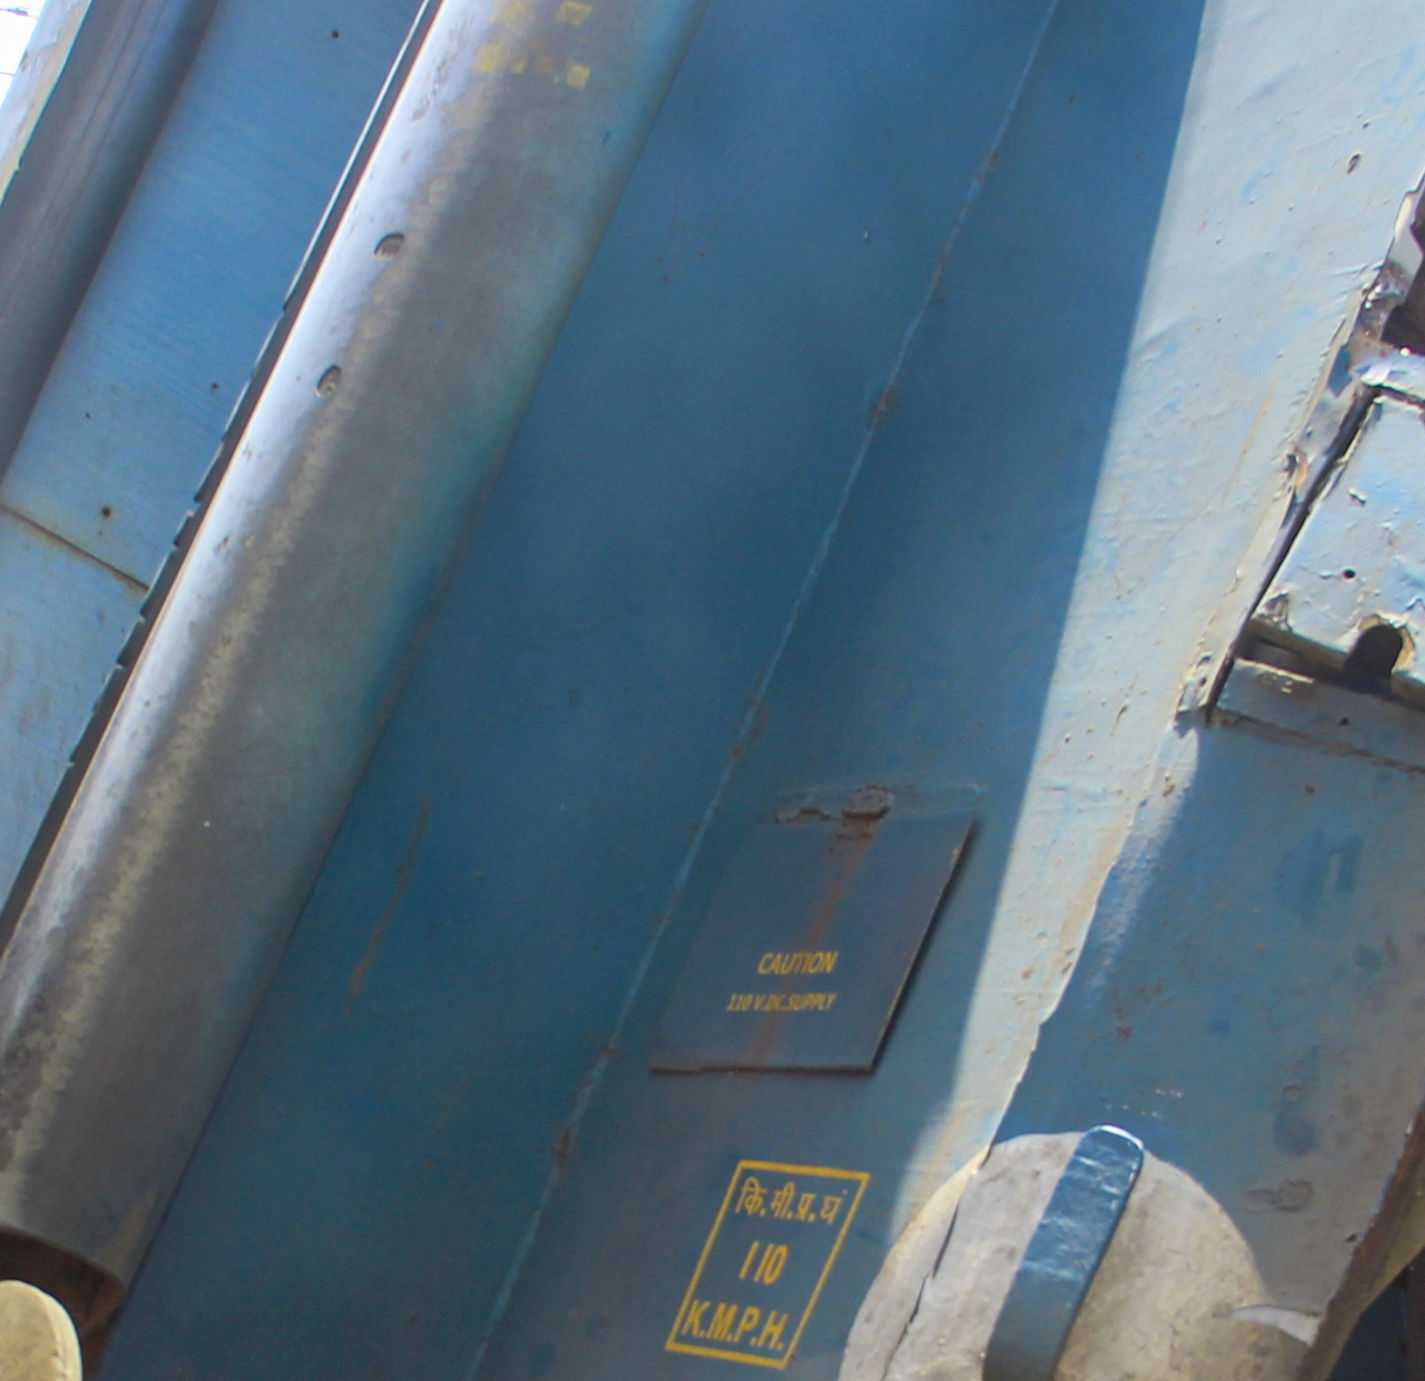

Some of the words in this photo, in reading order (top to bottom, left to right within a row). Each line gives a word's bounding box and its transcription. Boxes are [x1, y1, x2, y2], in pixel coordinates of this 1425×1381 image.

[758, 951, 838, 974] CAUTION
[738, 1241, 789, 1285] 110
[681, 1300, 789, 1350] K.M.P.H.
